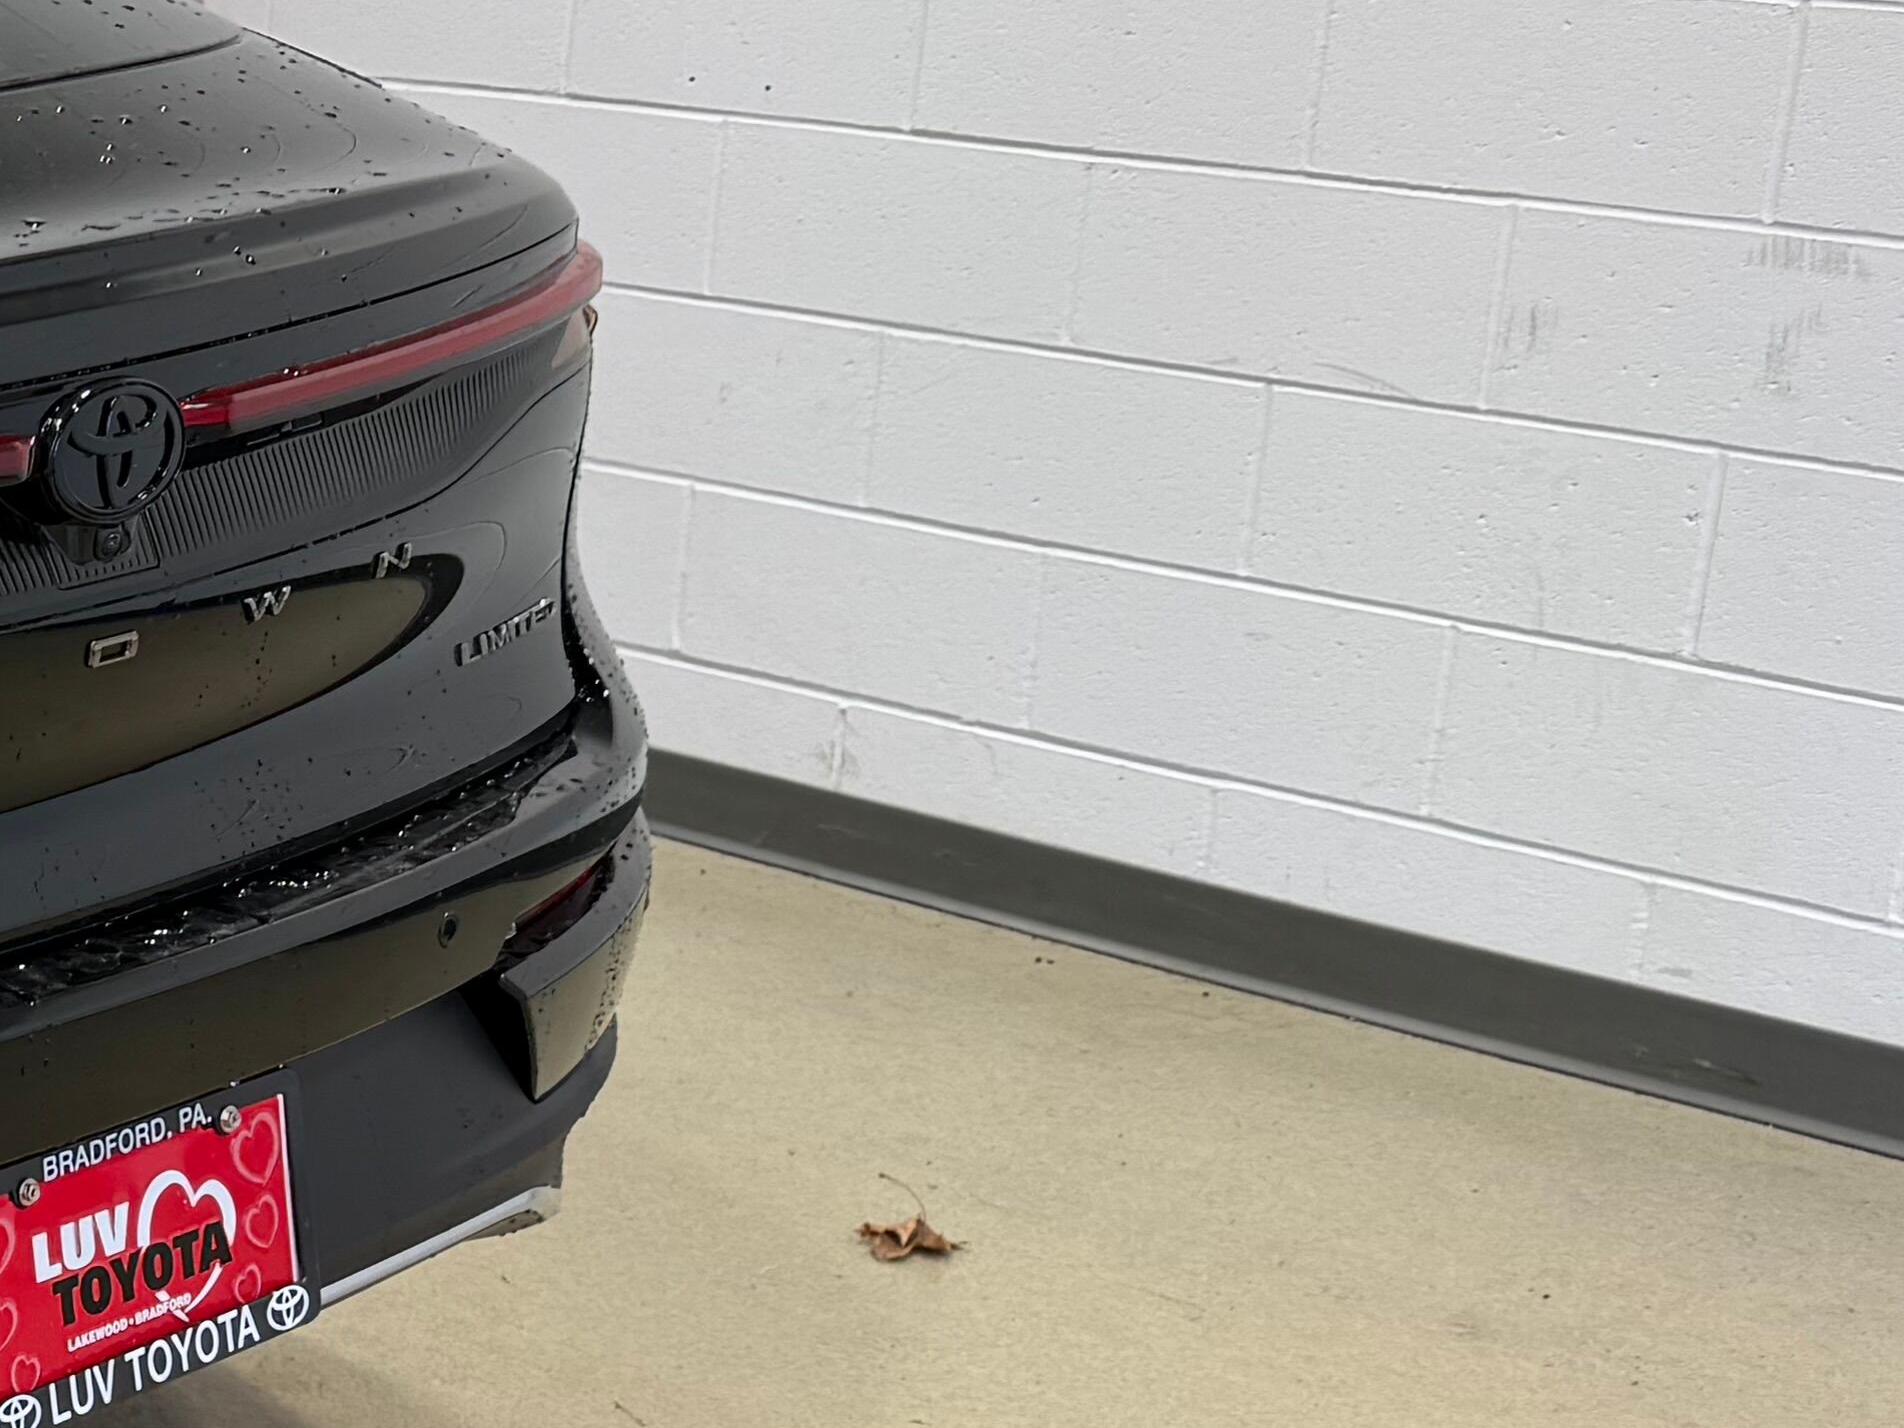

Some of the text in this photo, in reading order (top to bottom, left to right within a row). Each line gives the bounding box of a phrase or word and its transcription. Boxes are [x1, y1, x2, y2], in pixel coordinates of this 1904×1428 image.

[178, 1102, 213, 1134] PA.
[31, 1201, 131, 1284] LUV
[52, 1220, 234, 1328] TOYOTA
[48, 1304, 261, 1426] LUV TOYOTA
[67, 1318, 129, 1353] LAKEWOOD
